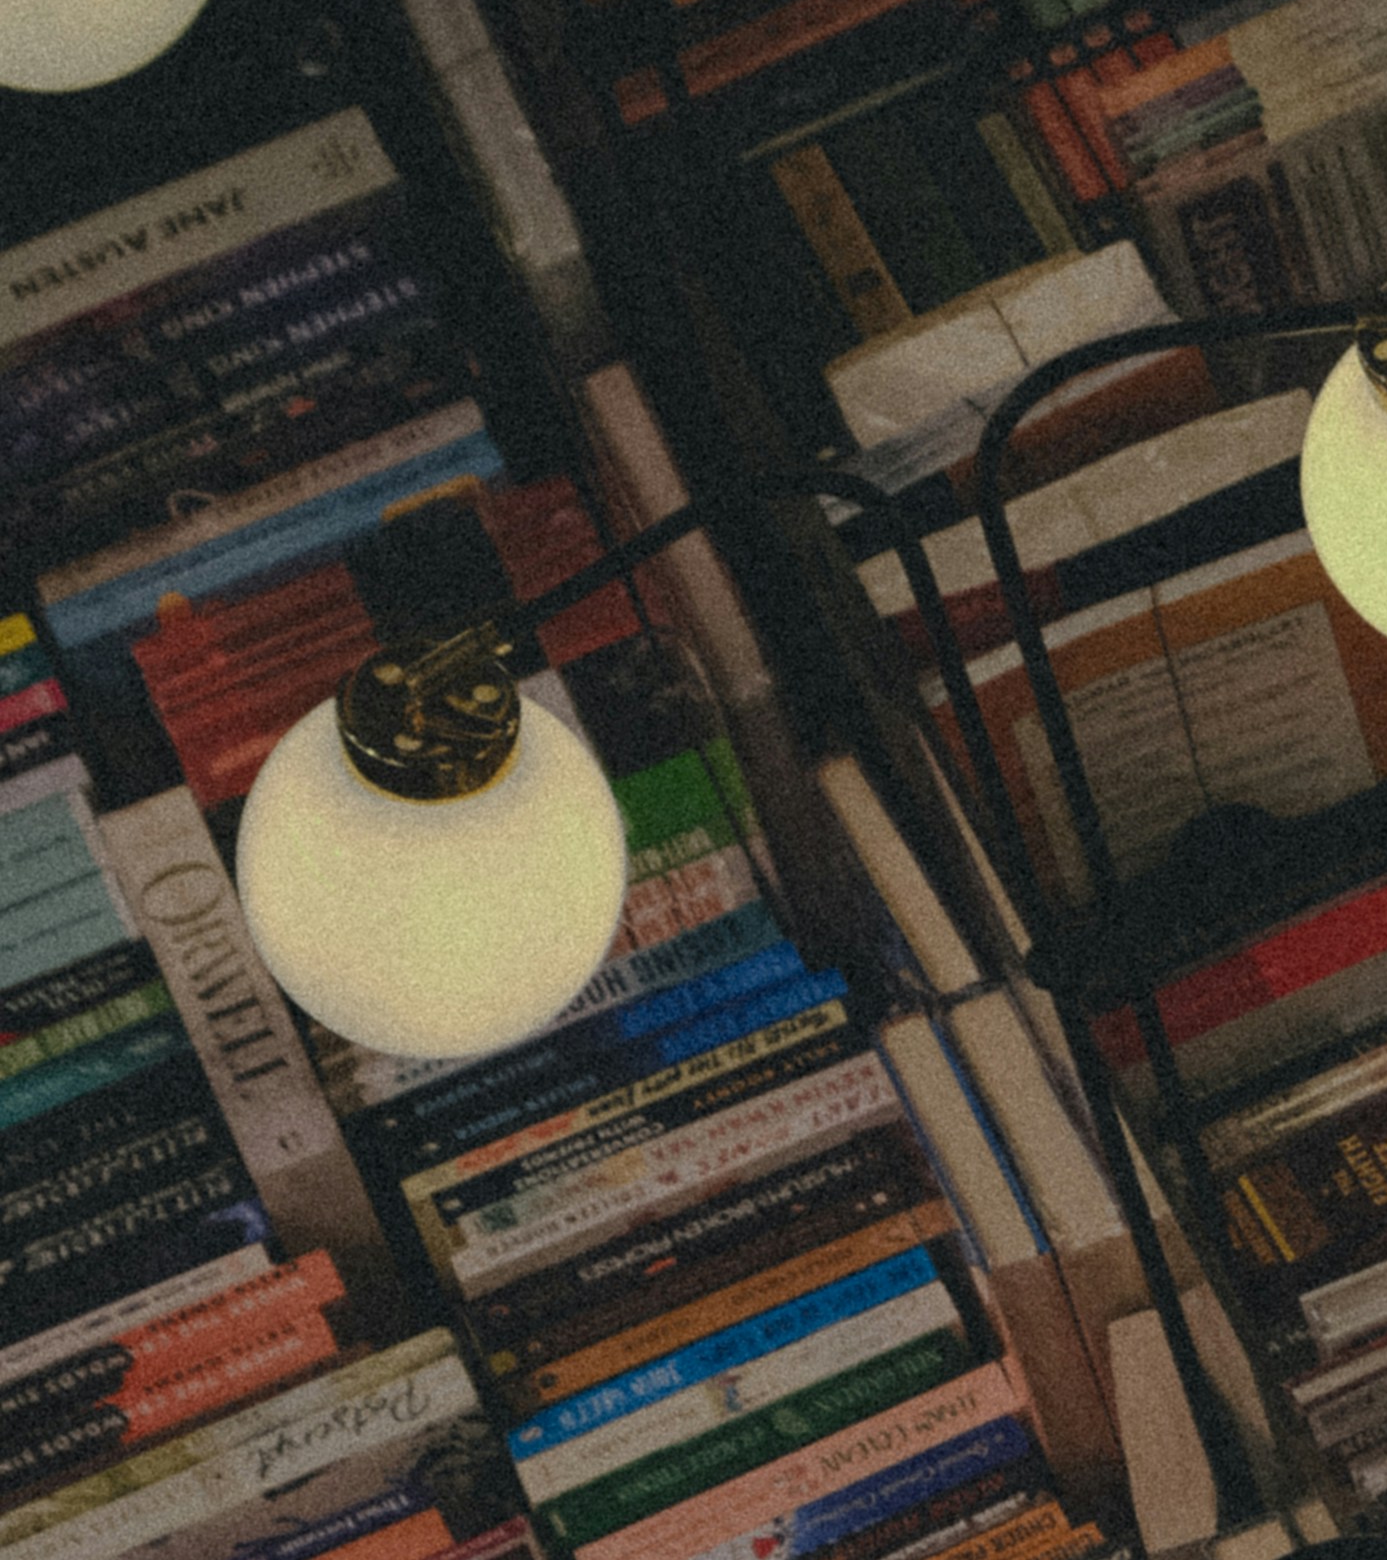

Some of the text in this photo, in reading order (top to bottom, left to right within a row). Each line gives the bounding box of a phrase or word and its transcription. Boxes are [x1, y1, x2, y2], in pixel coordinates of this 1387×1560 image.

[8, 185, 251, 303] JANE AUSTEN
[237, 239, 372, 308] STEPHEN
[284, 274, 418, 345] STEPHEN
[131, 854, 296, 1105] ORWELL
[242, 1374, 433, 1482] Postscript
